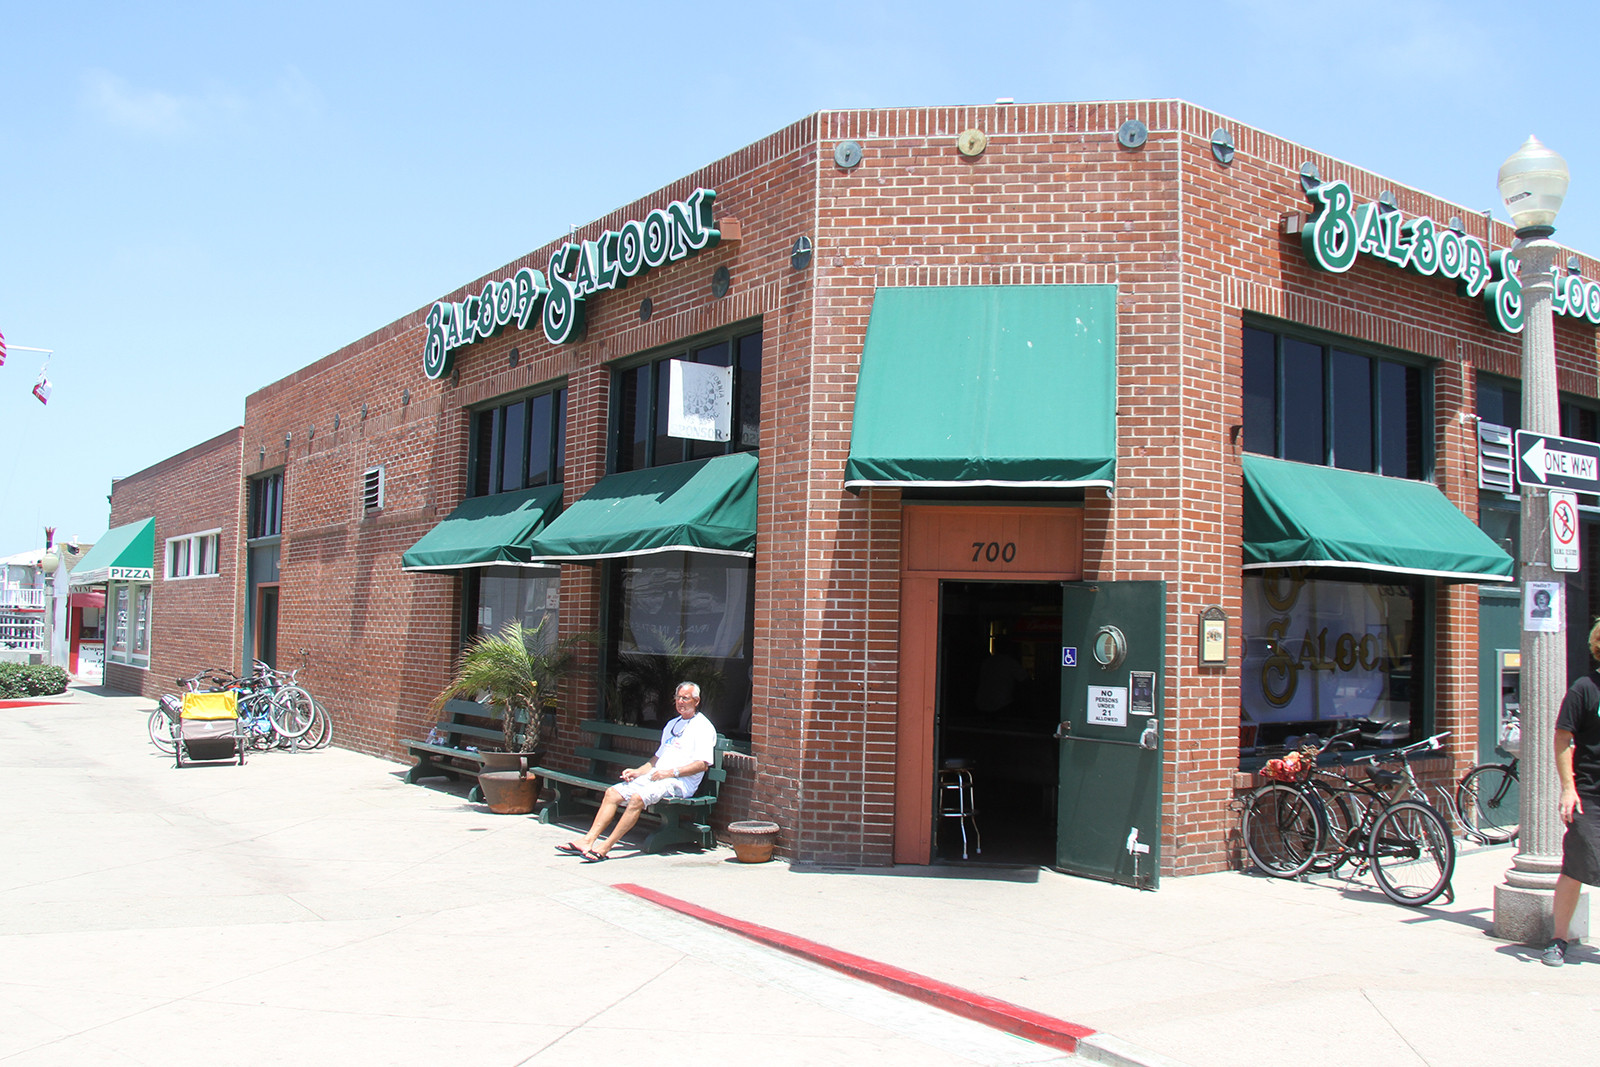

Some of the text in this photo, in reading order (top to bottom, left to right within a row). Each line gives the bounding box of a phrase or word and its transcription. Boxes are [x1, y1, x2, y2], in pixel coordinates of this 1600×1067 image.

[1304, 180, 1600, 333] BALBOA SLOO
[423, 187, 721, 380] BALBOA SALOON
[1545, 452, 1593, 477] ONE WAY
[972, 542, 1016, 563] 700
[111, 568, 151, 579] PIZZA
[73, 585, 91, 593] ATM
[1261, 616, 1405, 709] SALOON
